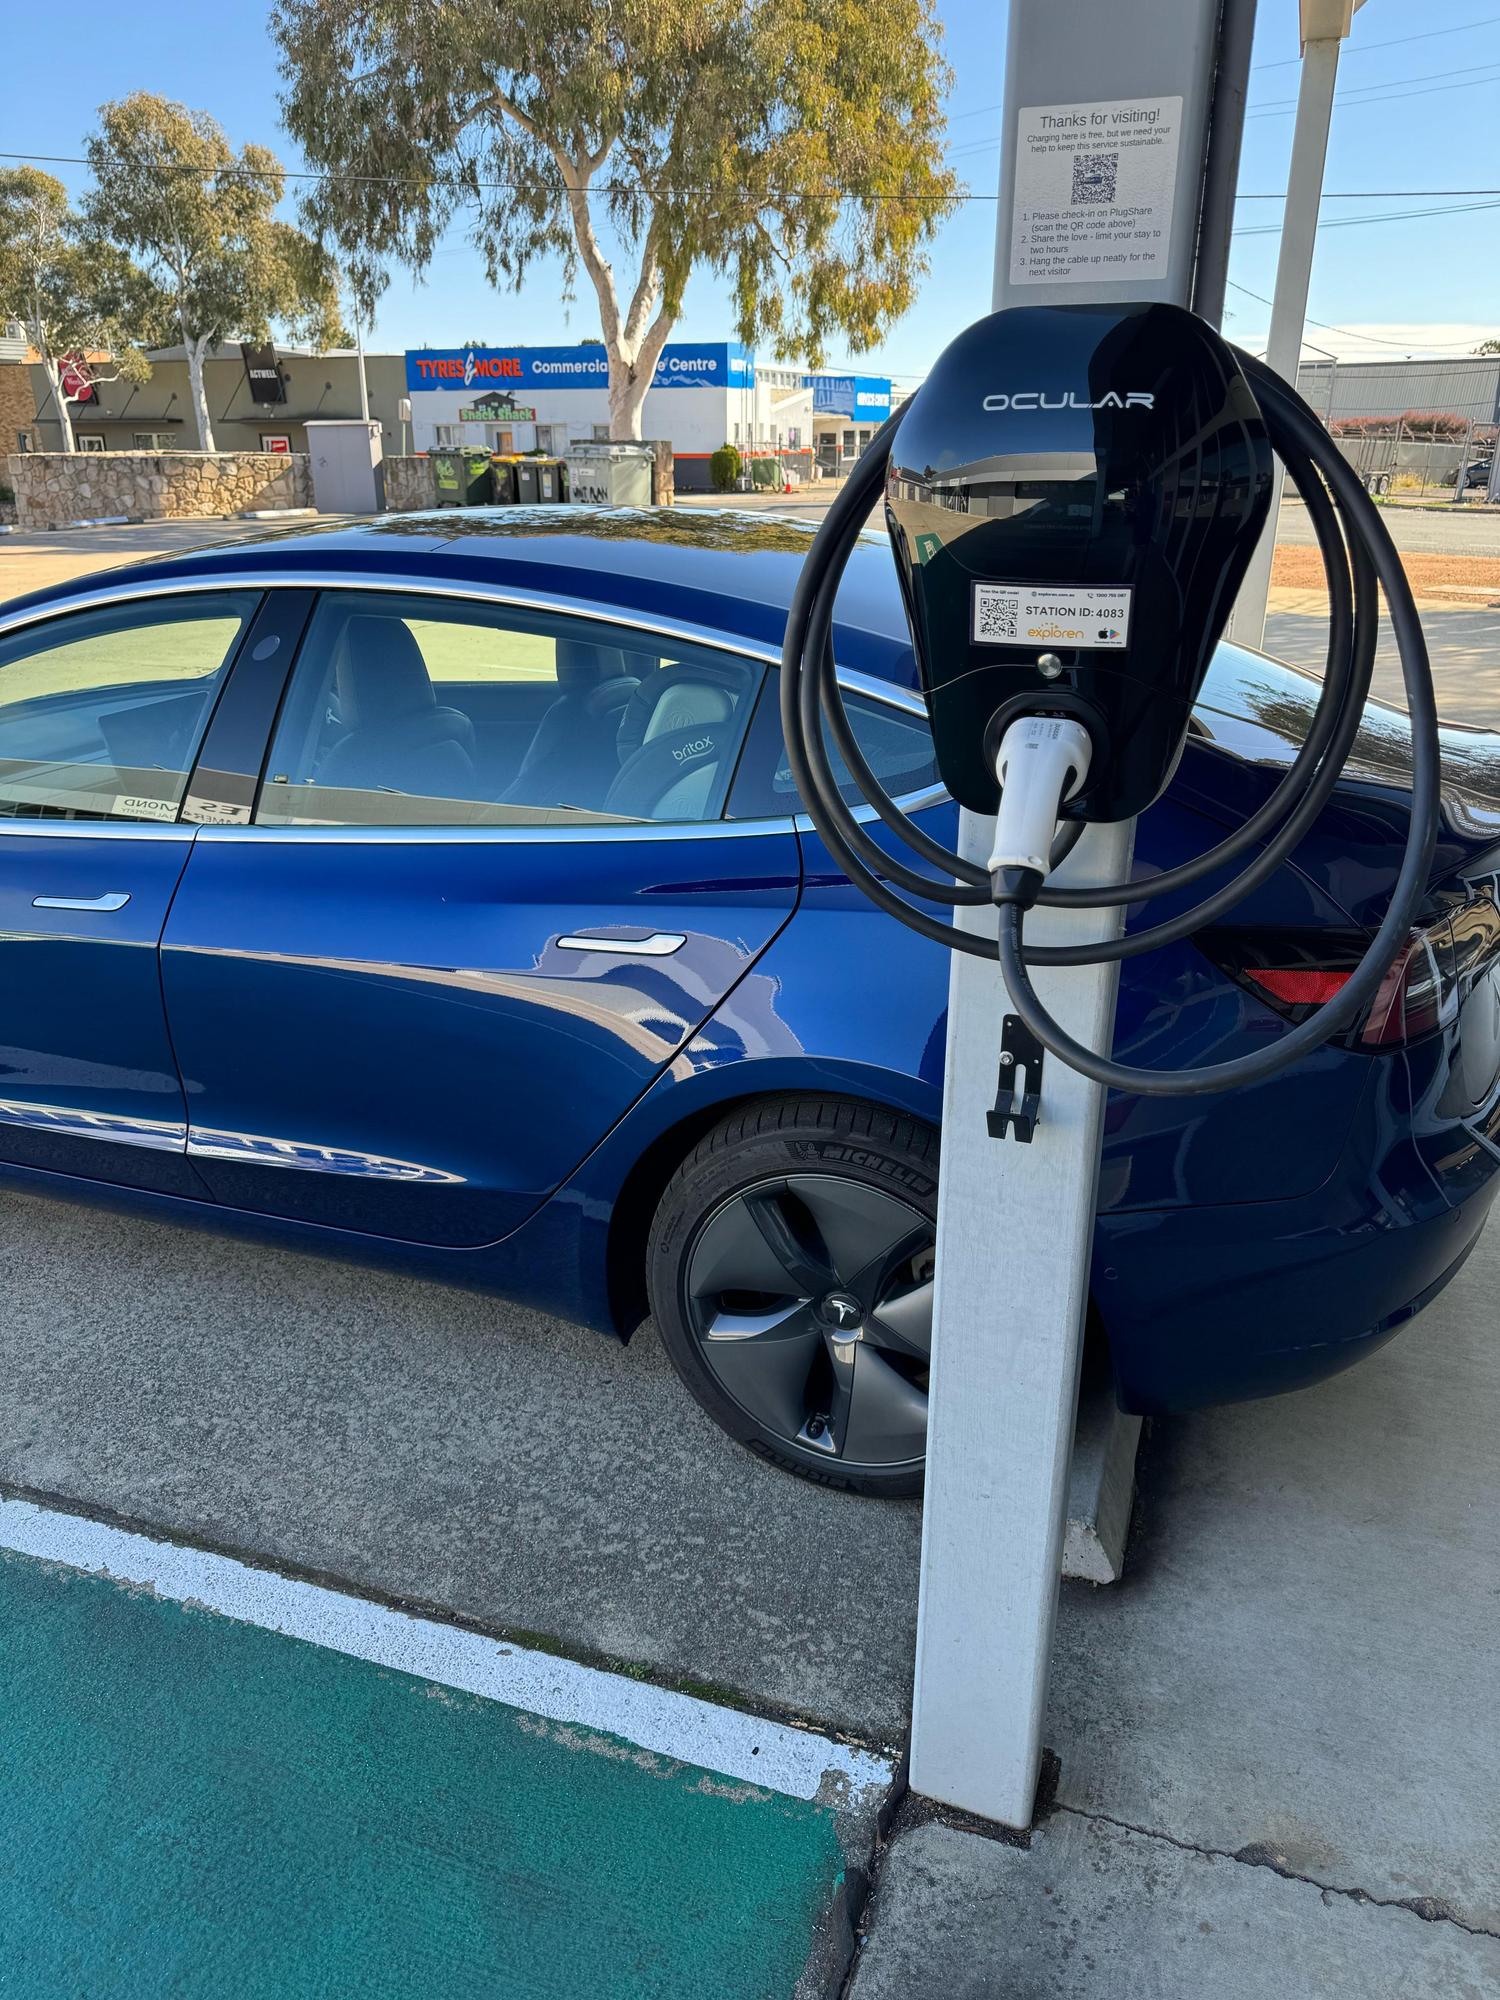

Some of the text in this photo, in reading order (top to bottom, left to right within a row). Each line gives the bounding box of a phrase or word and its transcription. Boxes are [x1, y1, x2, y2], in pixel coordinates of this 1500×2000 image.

[1040, 109, 1160, 128] Thanks for visiting!
[1028, 134, 1059, 144] Charging
[1062, 133, 1078, 141] here
[1107, 130, 1118, 138] but
[1134, 127, 1152, 136] need
[1155, 127, 1171, 136] your
[1031, 144, 1047, 153] help
[1058, 143, 1075, 152] keep
[1077, 142, 1090, 150] this
[1092, 140, 1118, 149] service
[1033, 211, 1059, 220] Please
[1062, 209, 1095, 219] check-in
[1110, 207, 1152, 219] PlugShare
[1032, 219, 1136, 233] (scan the QR code above)
[1031, 233, 1054, 243] Share
[1057, 233, 1069, 241] the
[1072, 233, 1088, 241] love
[1096, 232, 1111, 240] limit
[1114, 233, 1131, 241] your
[1134, 231, 1150, 239] stay
[1046, 245, 1068, 253] hours
[1030, 257, 1050, 266] Hang
[1053, 256, 1064, 264] the
[1067, 255, 1088, 264] cable
[1091, 256, 1100, 265] up
[1103, 253, 1127, 263] neatly
[1129, 253, 1140, 261] for
[1143, 252, 1155, 260] the
[1029, 267, 1071, 276] next visitor
[669, 358, 717, 372] Centre
[983, 391, 1155, 411] OCULAR
[461, 406, 534, 420] Snack Shack
[1026, 606, 1124, 618] STATION ID: 4083
[1028, 625, 1084, 640] exploren
[672, 736, 713, 760] britax
[823, 1145, 931, 1192] MICHELIN
